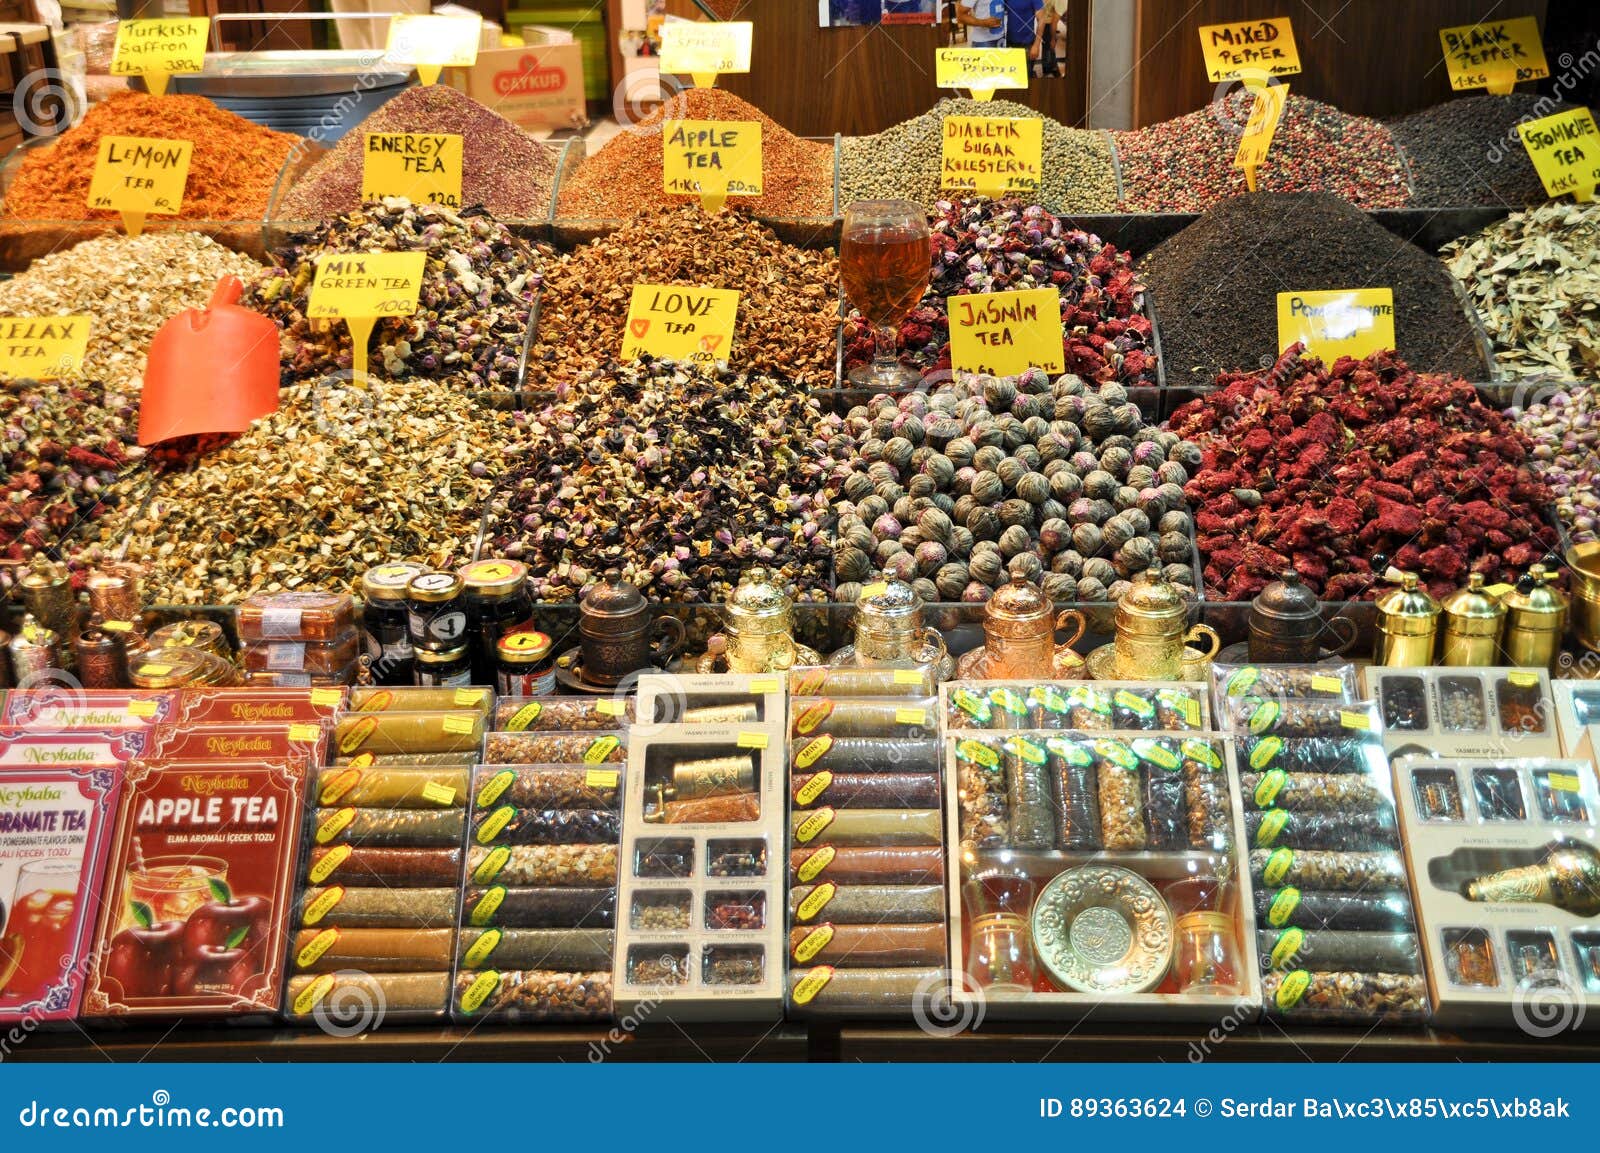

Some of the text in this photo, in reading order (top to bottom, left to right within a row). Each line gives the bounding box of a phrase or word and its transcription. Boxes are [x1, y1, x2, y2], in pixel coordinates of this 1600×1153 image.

[125, 20, 198, 38] Turkish
[1445, 25, 1511, 51] BLACK
[1218, 47, 1286, 65] PEPPER
[1455, 43, 1528, 69] PEPPER
[369, 135, 447, 156] ENERGY
[669, 128, 739, 147] APPLE
[107, 144, 183, 169] LEMON
[402, 156, 446, 173] TEA
[683, 152, 723, 170] TEA
[1553, 146, 1586, 166] TEA
[124, 176, 155, 189] TEA
[324, 261, 367, 276] MIX
[320, 277, 412, 290] GREEN TEA
[649, 291, 721, 317] LOVE
[664, 322, 696, 335] TEA
[974, 327, 1014, 347] TEA
[7, 345, 47, 358] TEA
[24, 747, 96, 763] Neybaba
[137, 796, 279, 825] APPLE TEA
[62, 809, 87, 832] TEA
[167, 834, 189, 844] ELMA
[254, 832, 276, 843] TOZU
